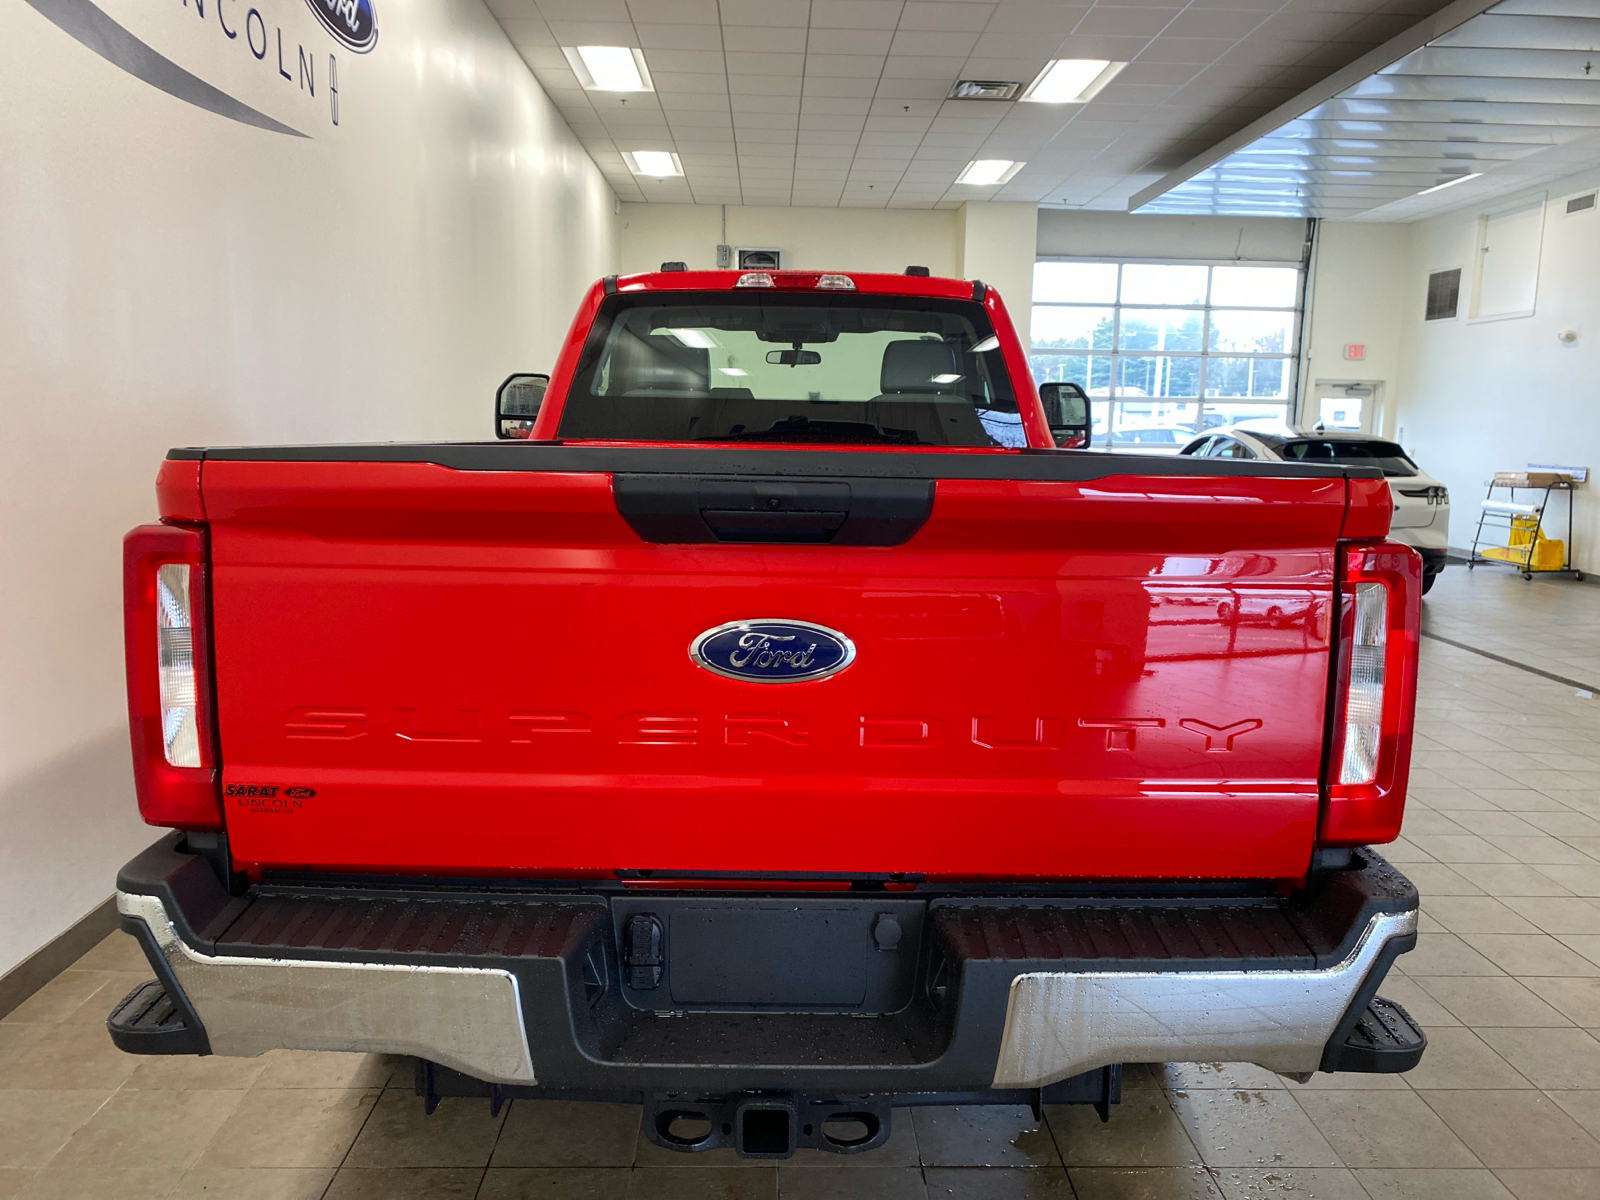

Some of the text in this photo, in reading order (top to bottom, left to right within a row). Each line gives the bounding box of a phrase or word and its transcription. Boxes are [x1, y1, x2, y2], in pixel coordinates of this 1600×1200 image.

[729, 632, 817, 668] Ford
[284, 705, 1264, 753] SUPER DUTY
[224, 784, 311, 797] SARAT Ford
[238, 798, 303, 808] LINCOLN
